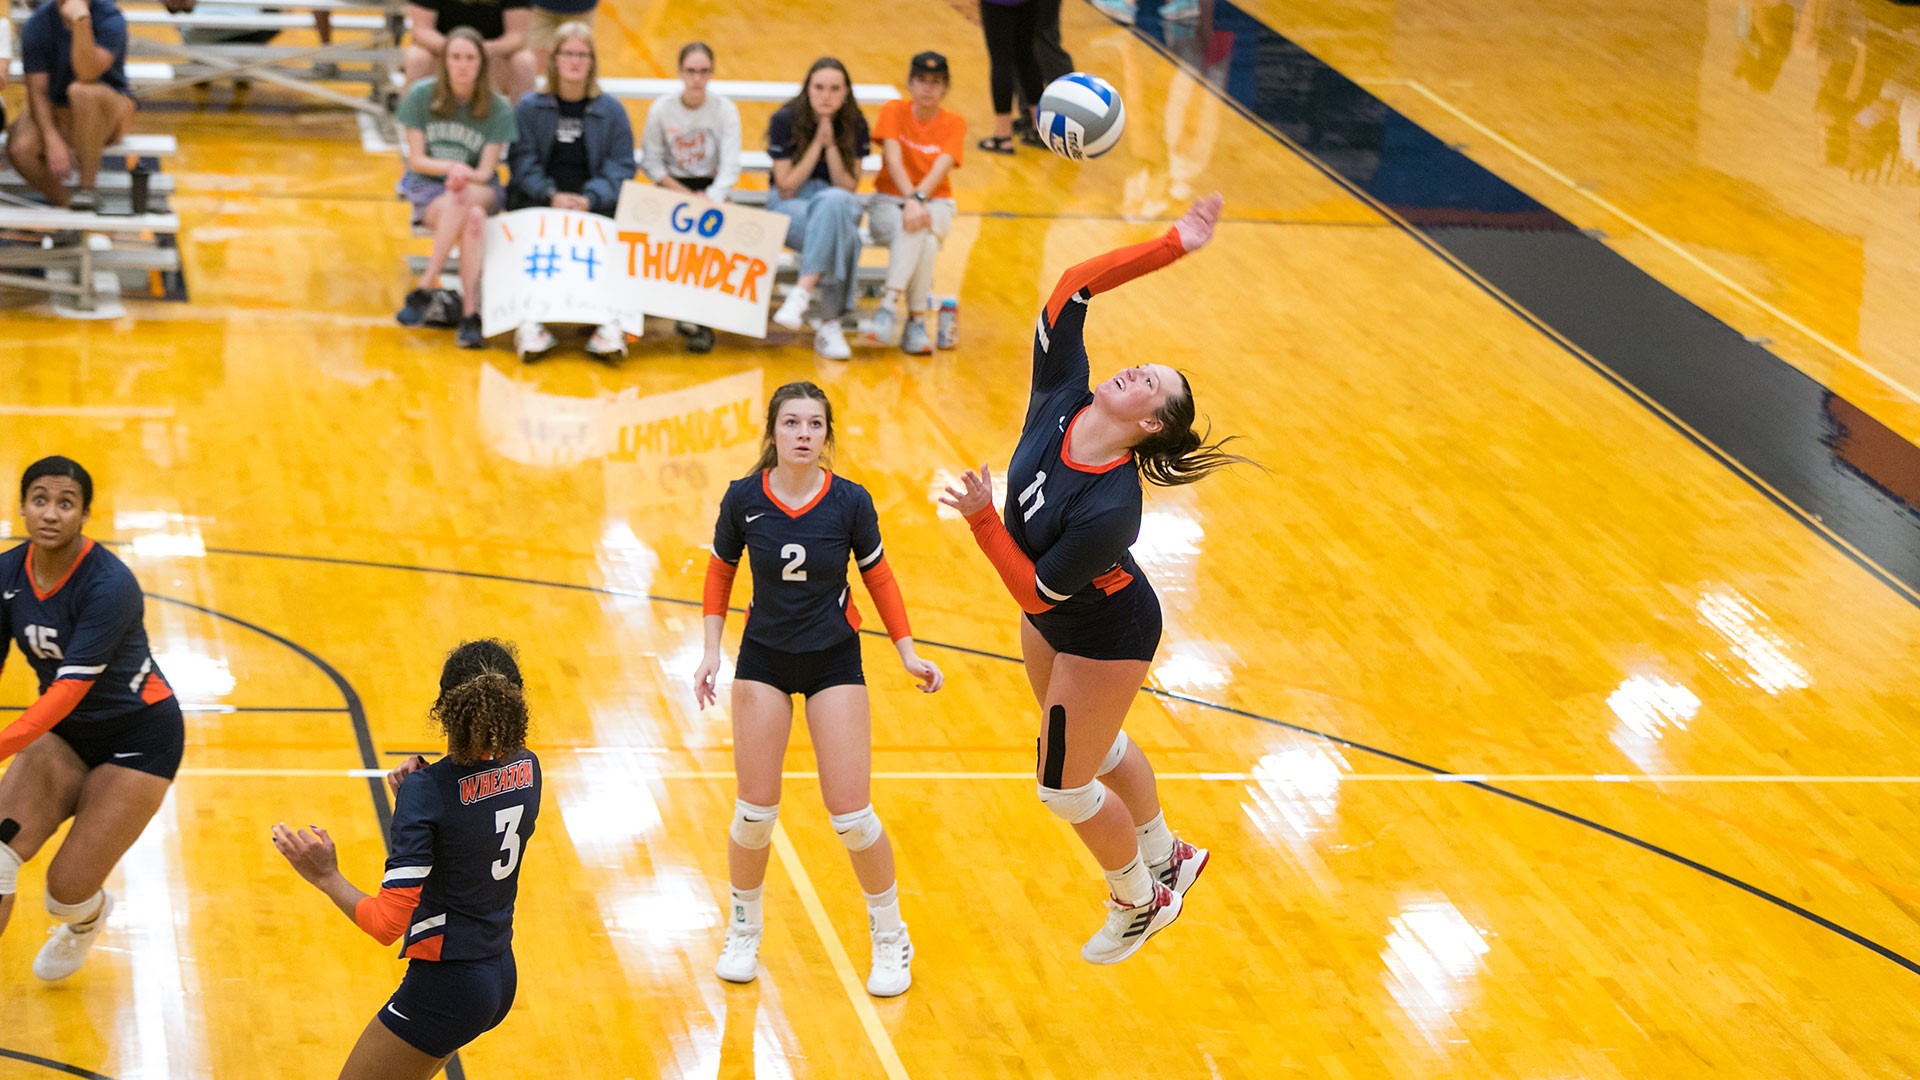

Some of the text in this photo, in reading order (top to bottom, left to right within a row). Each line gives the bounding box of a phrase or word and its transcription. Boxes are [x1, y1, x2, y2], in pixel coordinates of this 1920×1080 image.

[671, 202, 724, 239] GO
[524, 243, 602, 281] #4
[618, 231, 768, 304] THUNDER
[780, 543, 808, 582] 2
[24, 624, 65, 660] 15
[458, 759, 534, 805] WHEATON
[491, 804, 525, 881] 3
